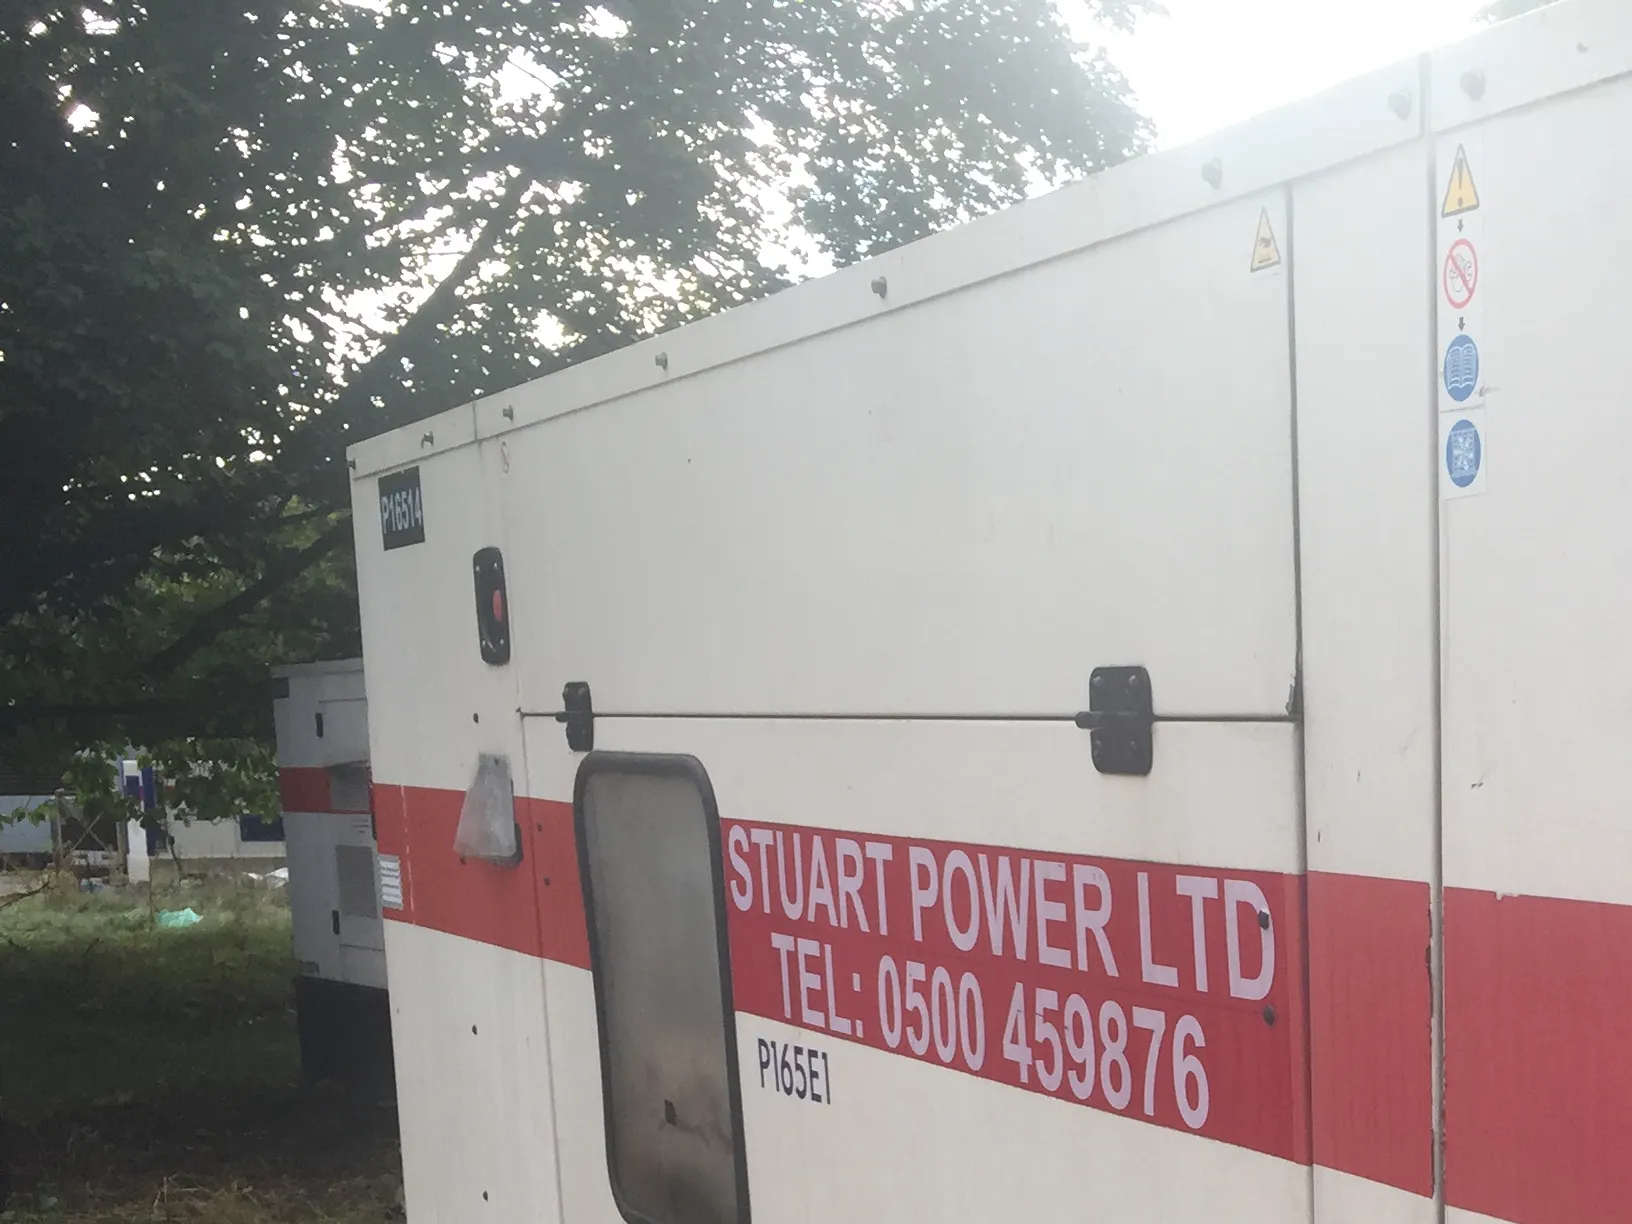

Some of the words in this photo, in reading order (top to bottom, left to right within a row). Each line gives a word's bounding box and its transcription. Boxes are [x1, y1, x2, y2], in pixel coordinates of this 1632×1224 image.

[728, 824, 893, 936] STUART
[908, 846, 1119, 977] POWER
[1137, 872, 1275, 1000] LTD
[757, 1037, 831, 1105] P165E1
[771, 932, 864, 1038] TEL:
[878, 955, 985, 1071] 0500
[1002, 981, 1209, 1129] 459876
